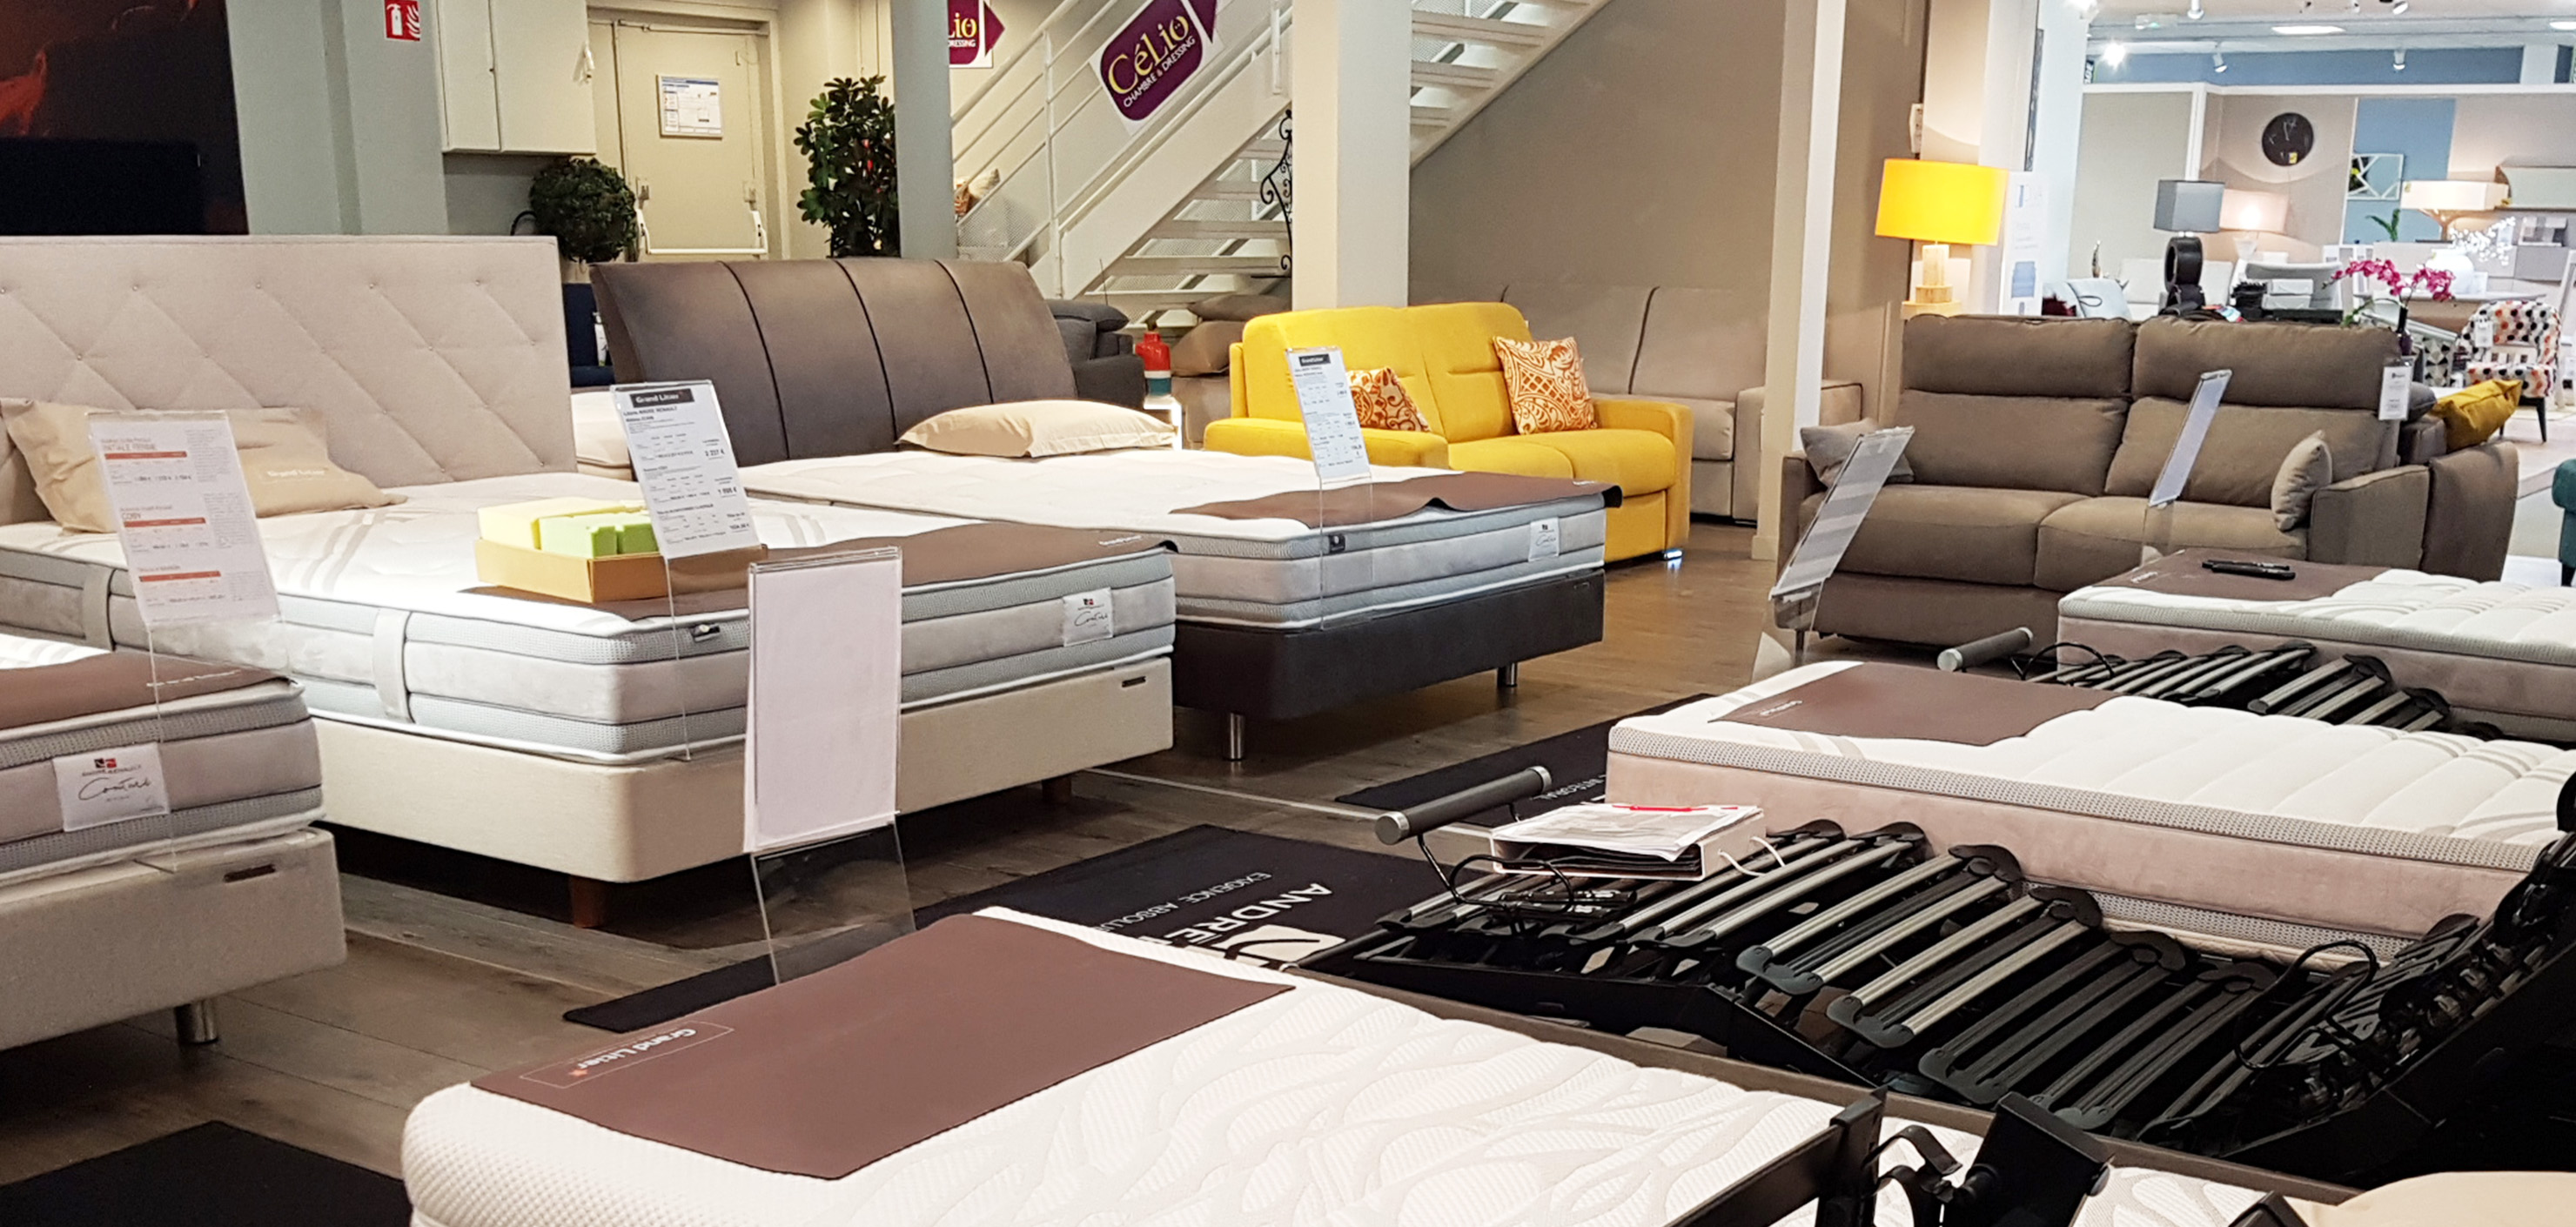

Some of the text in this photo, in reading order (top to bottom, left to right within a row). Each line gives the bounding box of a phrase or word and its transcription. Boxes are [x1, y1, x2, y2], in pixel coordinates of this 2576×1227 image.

[1124, 73, 1157, 108] CHAMBRE
[1161, 35, 1196, 71] DRESSING
[635, 393, 659, 404] Grand
[1178, 871, 1272, 904] EXIGENCE
[577, 1029, 696, 1069] Grand Litier
